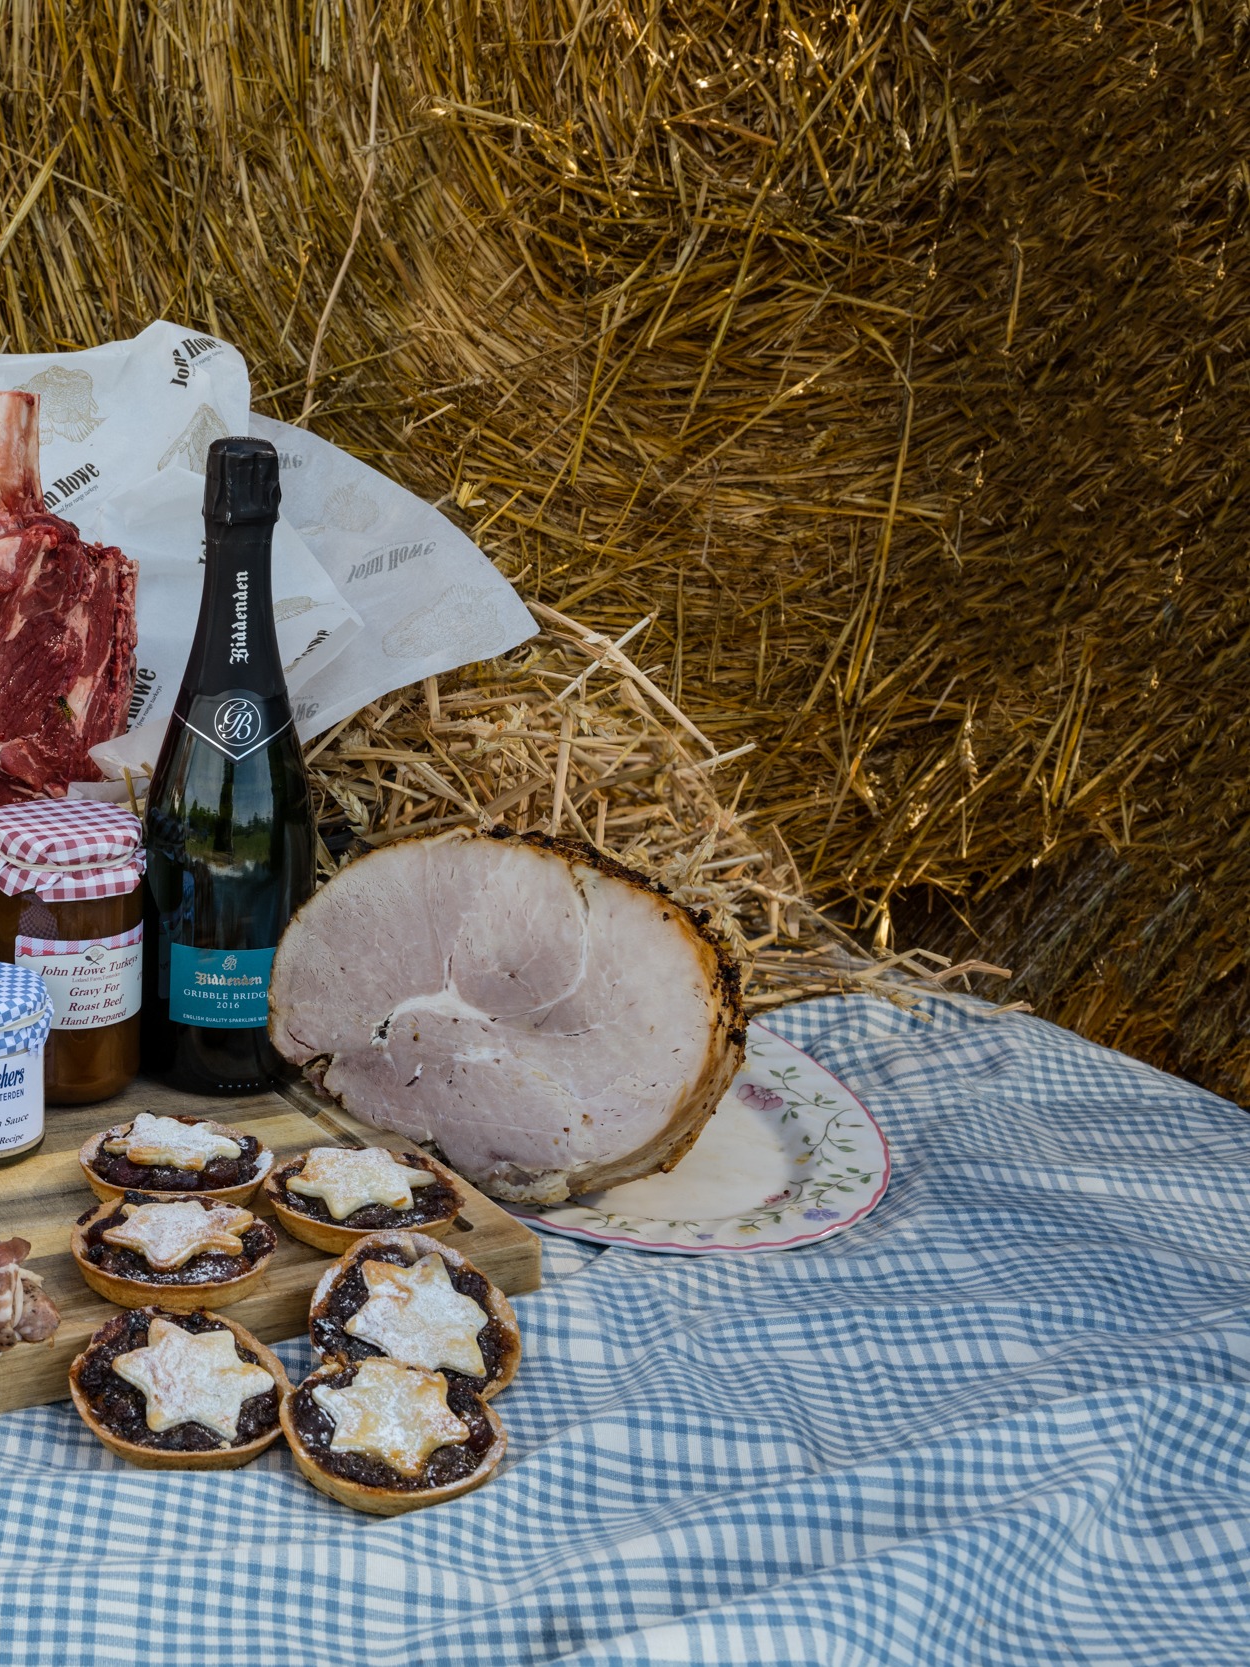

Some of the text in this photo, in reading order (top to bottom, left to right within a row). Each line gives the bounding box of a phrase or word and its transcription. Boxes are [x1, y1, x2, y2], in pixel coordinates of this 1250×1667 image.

[52, 463, 100, 498] Howe
[229, 570, 249, 665] Biddenden
[40, 954, 138, 977] John Howe Turkeys
[194, 971, 262, 986] Biddenden
[69, 983, 121, 997] Gravy For
[183, 988, 229, 1000] GRIBBLE
[68, 994, 125, 1012] Roast Beef
[59, 1008, 127, 1026] Hand Prepared
[183, 1013, 204, 1021] ENGLISH
[4, 1113, 29, 1126] Sauce
[0, 1133, 24, 1145] Recipe
